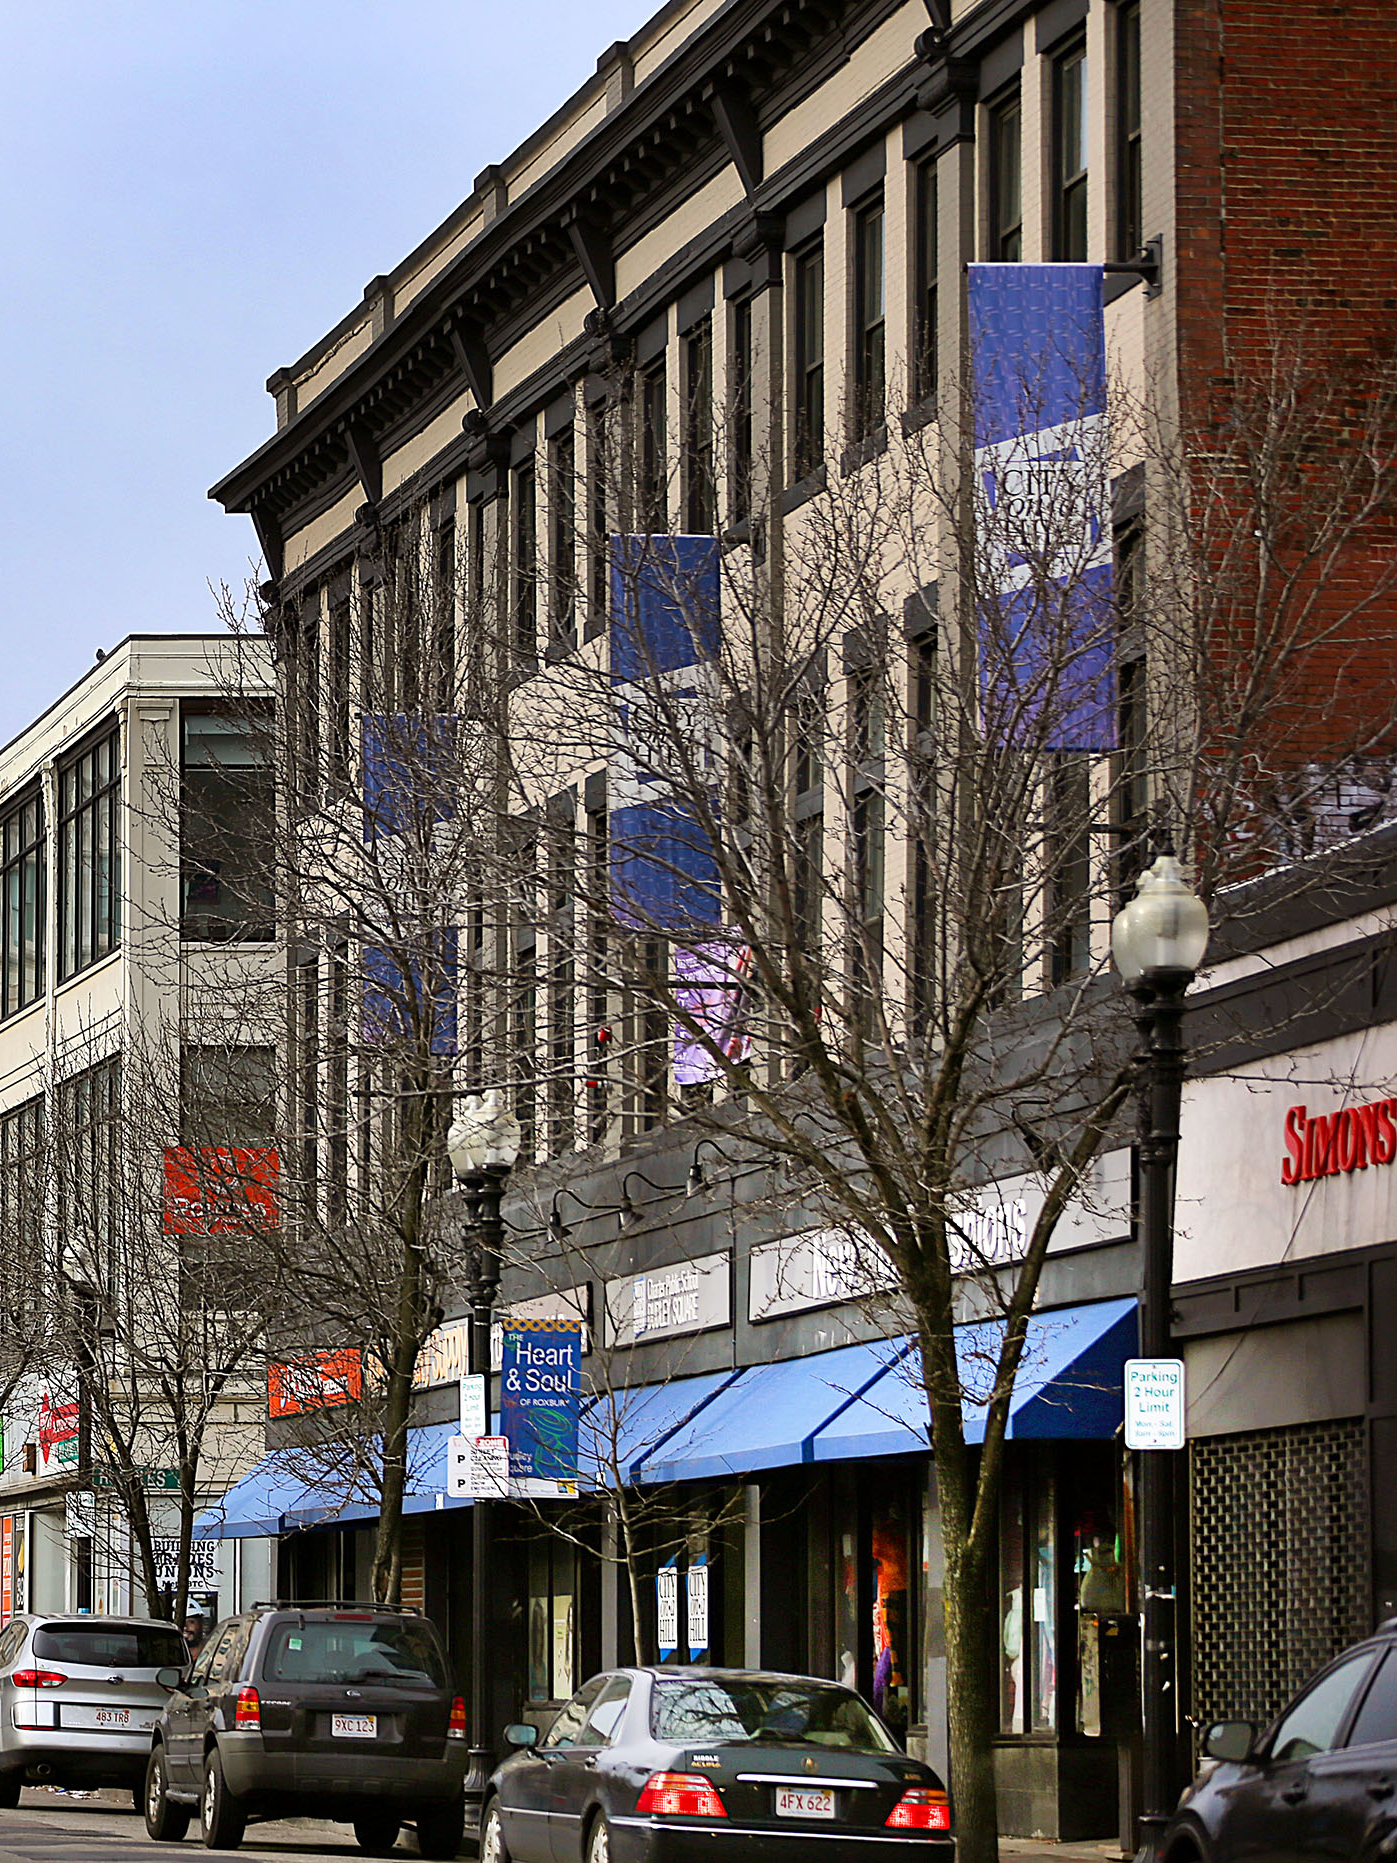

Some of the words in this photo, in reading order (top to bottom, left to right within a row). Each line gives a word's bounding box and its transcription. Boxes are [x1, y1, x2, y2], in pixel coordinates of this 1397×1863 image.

[1281, 1097, 1397, 1186] SIMONS
[508, 1333, 523, 1341] THE
[516, 1343, 574, 1366] Heart
[506, 1368, 522, 1391] &
[525, 1368, 572, 1392] Soul
[1131, 1371, 1178, 1385] Parking
[1134, 1386, 1141, 1397] 2
[1145, 1387, 1175, 1397] Hour
[533, 1399, 570, 1407] ROXBURY
[1139, 1402, 1170, 1412] Limit
[509, 1462, 533, 1474] quare
[95, 1711, 112, 1722] 483
[334, 1719, 353, 1731] 9XC
[356, 1721, 375, 1732] 123
[779, 1795, 804, 1809] 4FX
[807, 1797, 831, 1811] 622
